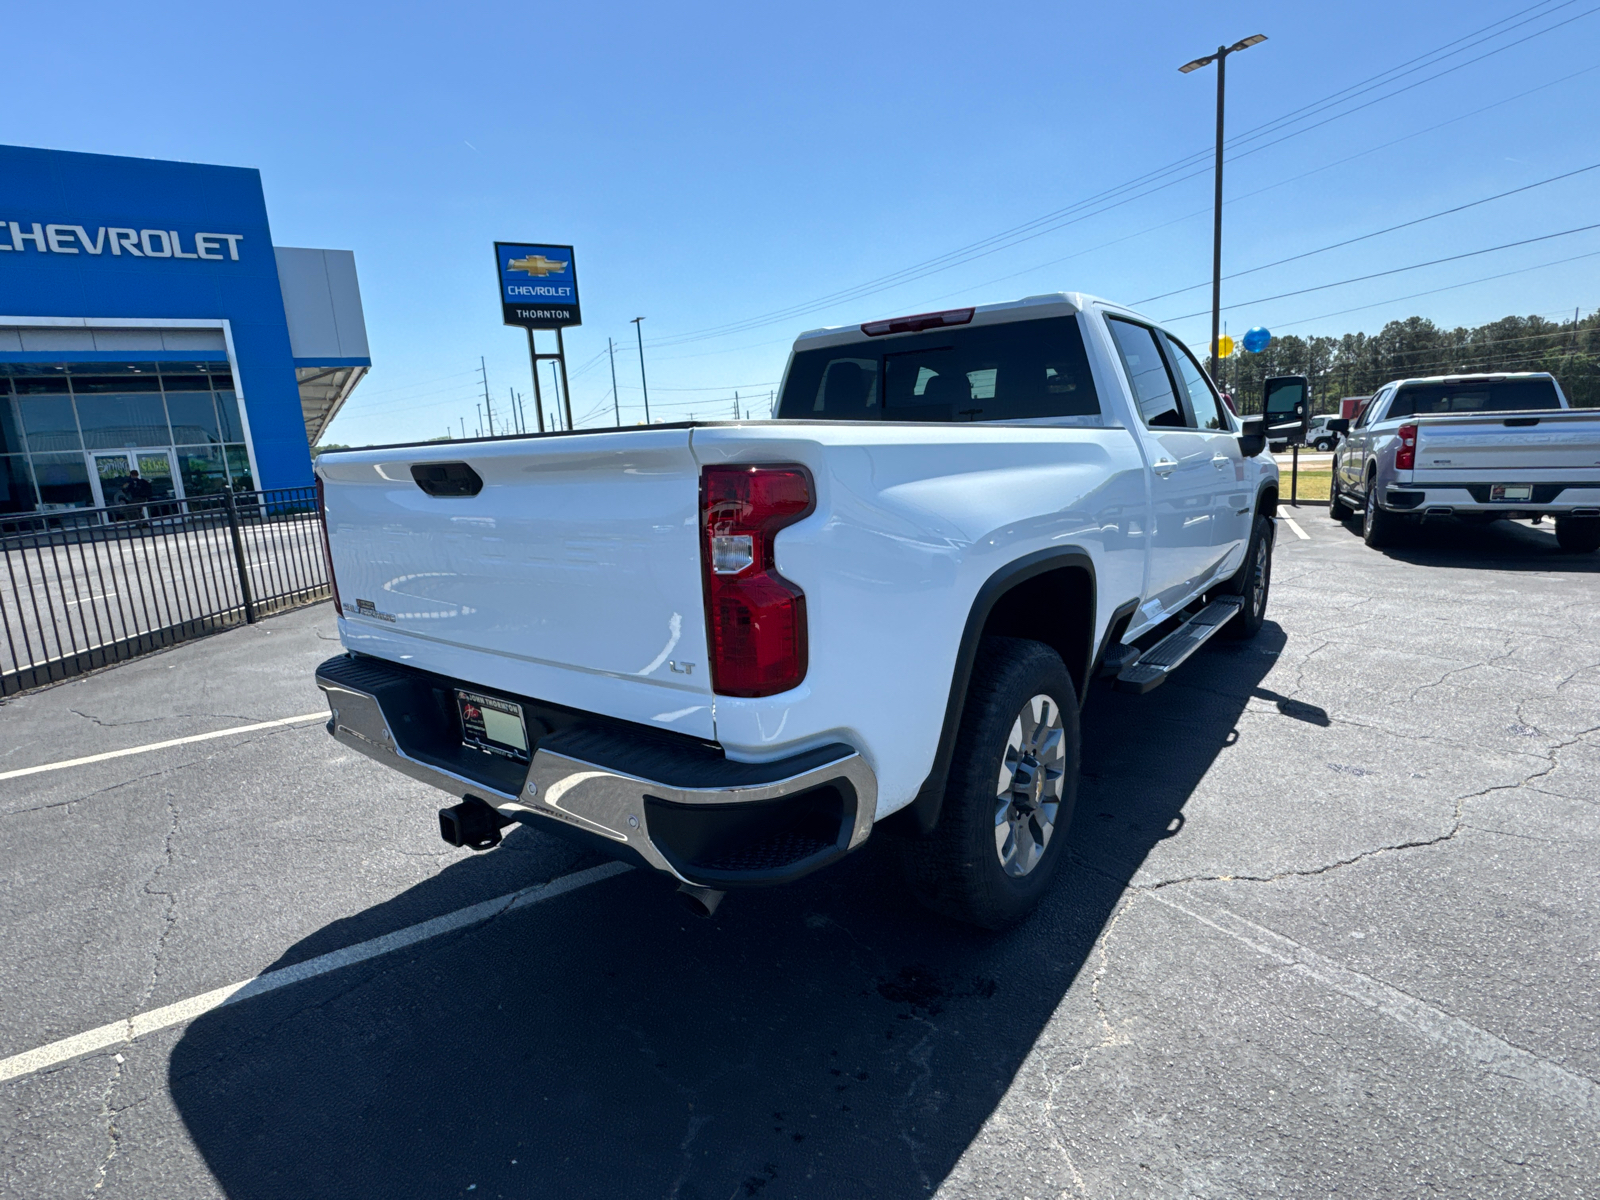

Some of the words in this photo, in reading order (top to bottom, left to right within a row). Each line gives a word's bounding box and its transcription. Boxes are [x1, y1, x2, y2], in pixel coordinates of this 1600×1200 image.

[507, 285, 572, 297] CHEVROLET
[516, 309, 570, 319] THORNTON
[669, 660, 695, 674] LT
[469, 694, 485, 704] JOHN
[485, 699, 518, 713] THORNTON
